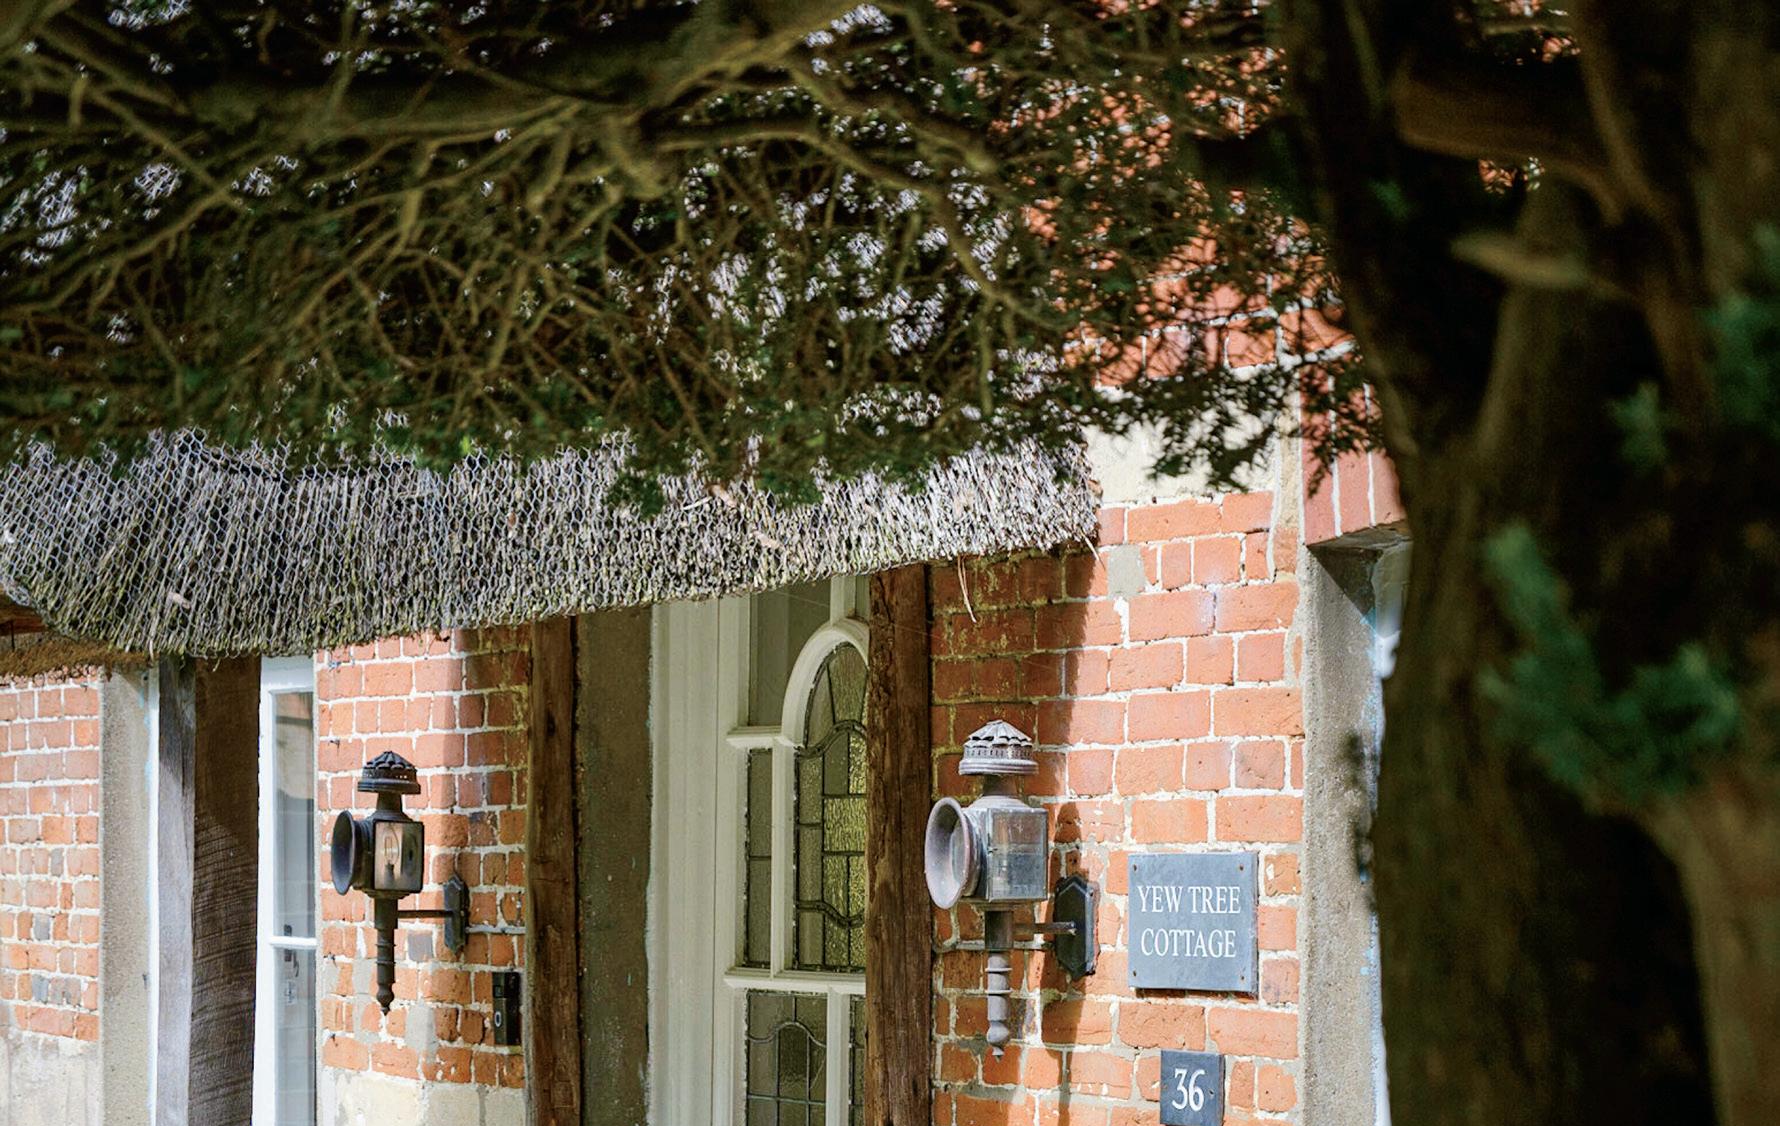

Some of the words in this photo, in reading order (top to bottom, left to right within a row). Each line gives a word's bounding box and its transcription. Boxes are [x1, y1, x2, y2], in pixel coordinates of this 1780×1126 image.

[1138, 886, 1183, 913] YEW
[1188, 886, 1241, 914] TREE
[1141, 928, 1236, 958] COTTAGE
[1172, 1068, 1205, 1112] 36
